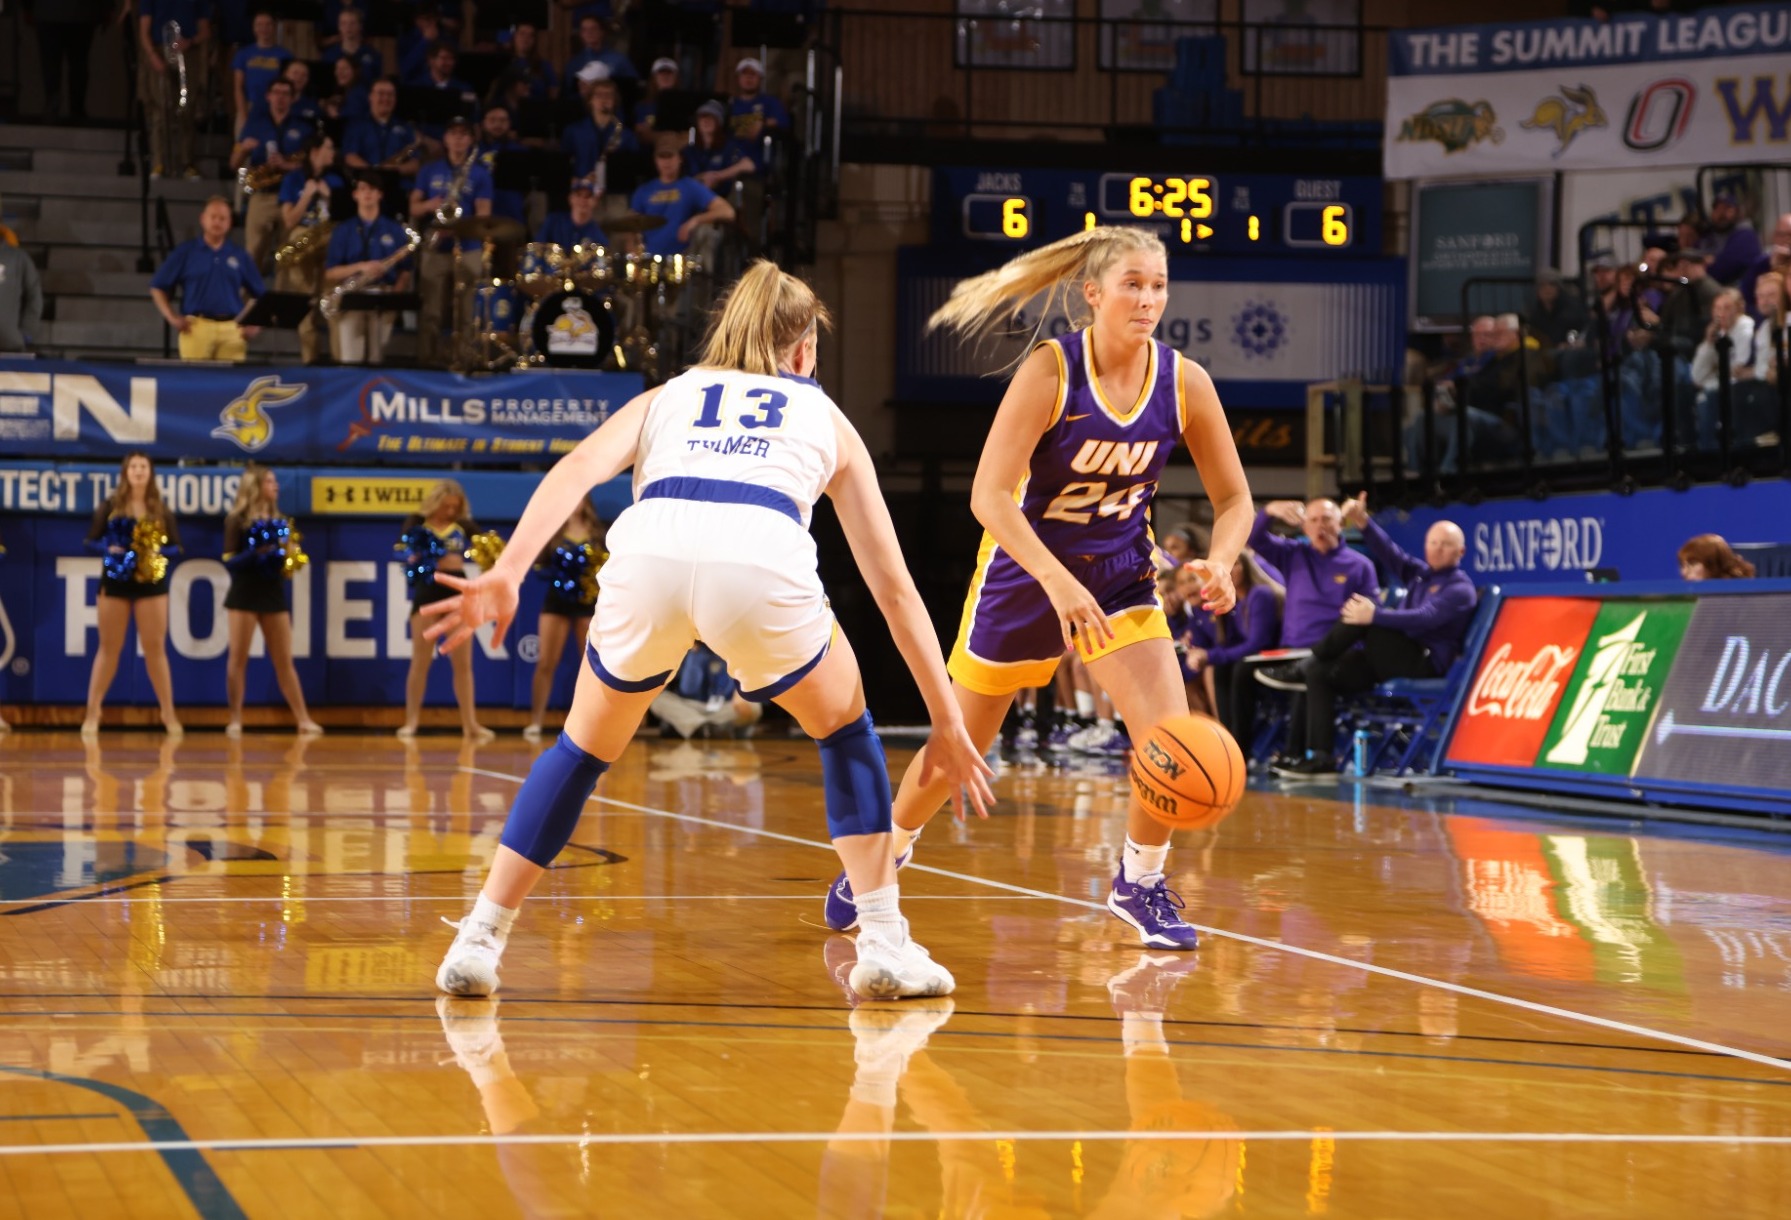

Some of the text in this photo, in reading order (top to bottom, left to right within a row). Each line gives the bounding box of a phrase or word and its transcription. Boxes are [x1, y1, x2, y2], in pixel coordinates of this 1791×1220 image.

[1408, 10, 1791, 67] THE SUMMIT LEAGU
[976, 172, 1023, 192] JACKS
[1129, 177, 1212, 218] 6:25
[1293, 178, 1342, 200] GUEST
[1003, 198, 1028, 238] 6
[1180, 218, 1192, 243] 1
[1248, 215, 1260, 241] 1
[1322, 205, 1347, 245] 6
[491, 398, 609, 412] PROPERTY
[691, 382, 790, 430] 13
[1071, 439, 1159, 476] UNI
[160, 474, 242, 514] HOUS
[1043, 480, 1158, 525] 24
[1474, 517, 1603, 572] SANFORD
[1618, 642, 1657, 675] First
[1589, 714, 1627, 748] Trust
